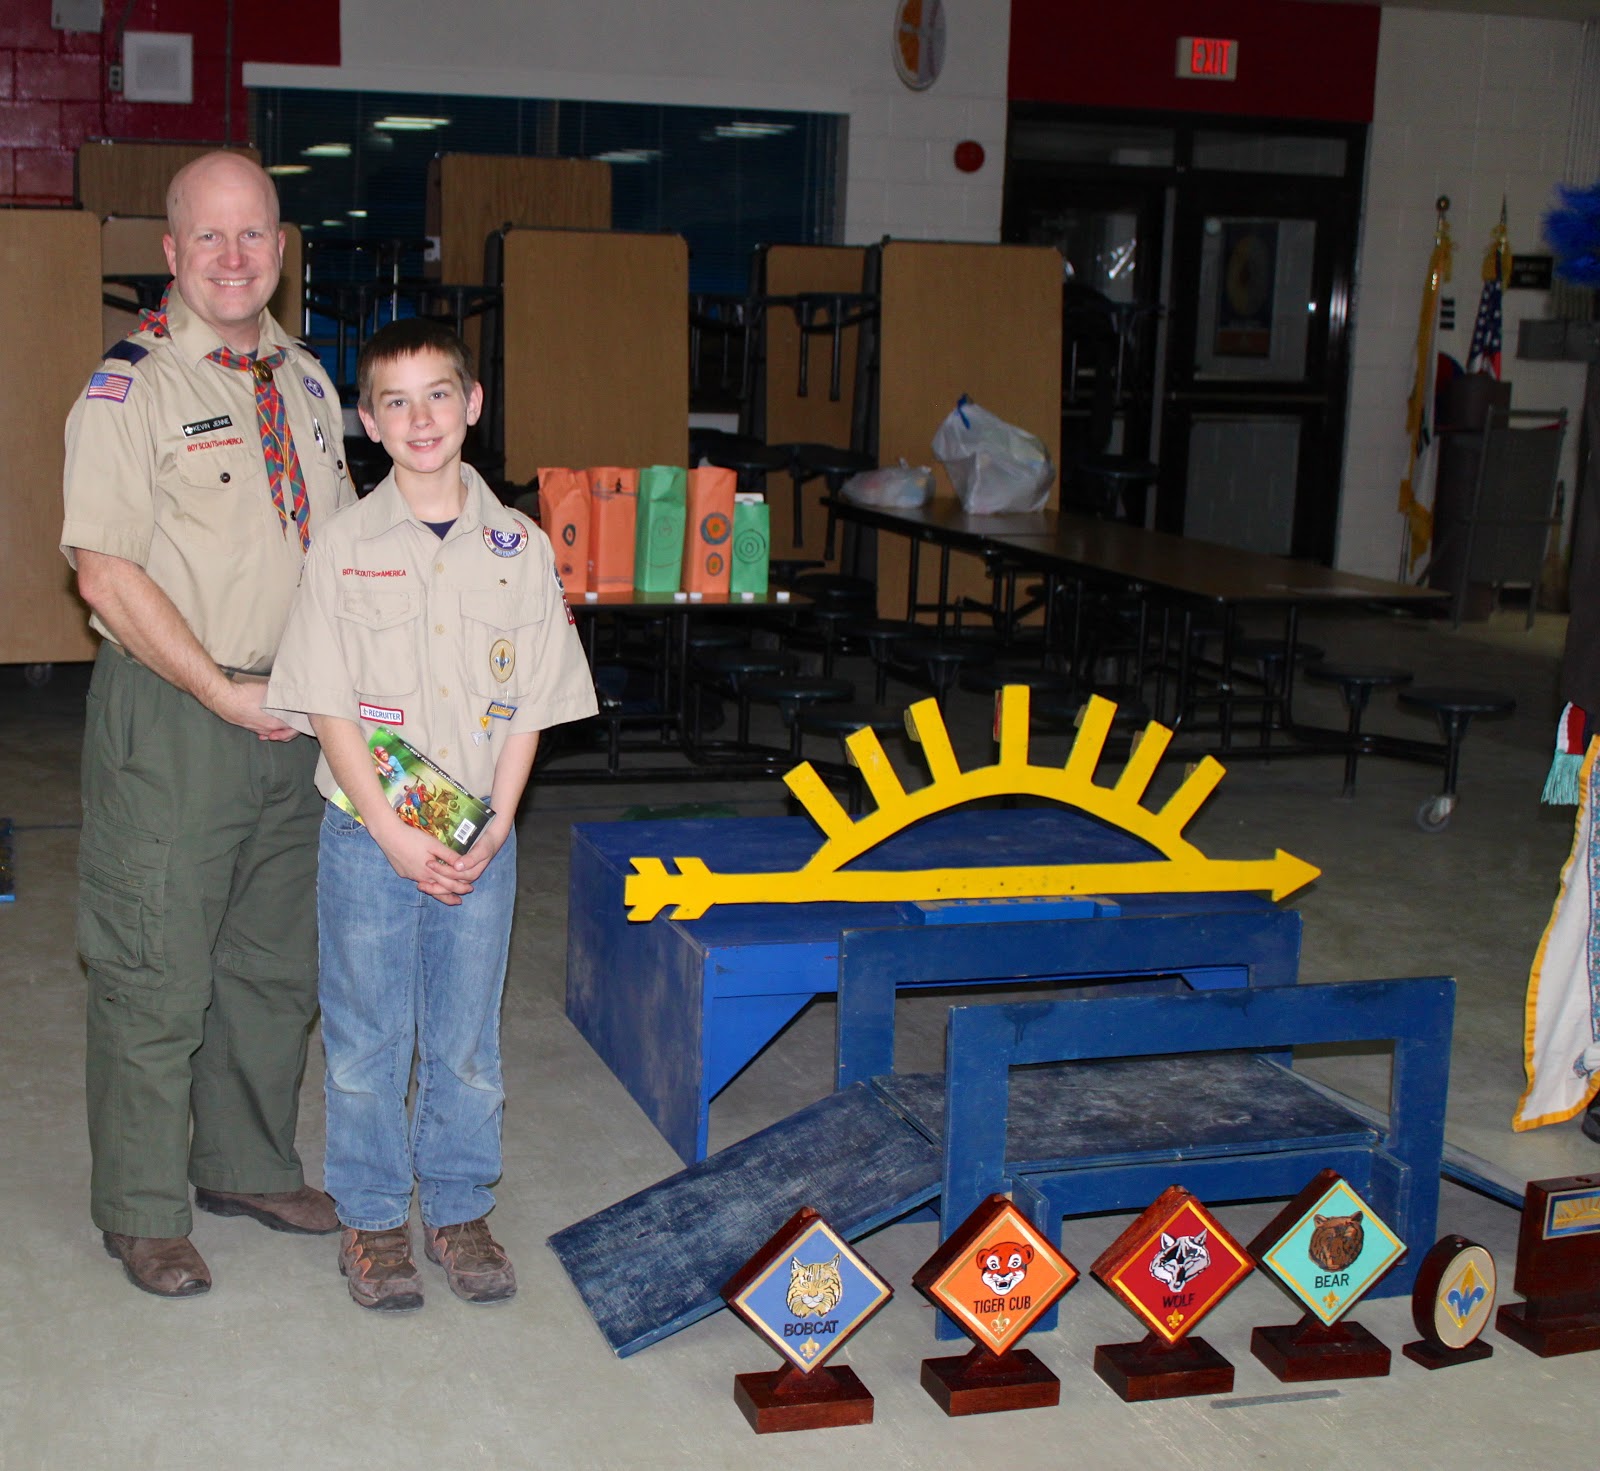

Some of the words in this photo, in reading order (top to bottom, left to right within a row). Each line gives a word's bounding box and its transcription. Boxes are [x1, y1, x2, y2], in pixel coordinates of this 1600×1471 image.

[1191, 37, 1231, 75] EXIT
[193, 422, 211, 432] KEVIN
[187, 443, 198, 452] BOY
[199, 440, 219, 450] SCOUTS
[222, 437, 244, 447] AMERICA
[342, 568, 354, 576] BOY
[354, 569, 376, 578] SCOUTS
[381, 569, 407, 577] AMERICA
[368, 708, 401, 721] RECRUITER
[420, 757, 440, 773] SCOUT
[1314, 1272, 1350, 1289] BEAR
[973, 1298, 1006, 1314] TIGER
[1009, 1295, 1031, 1311] CUB
[1162, 1292, 1197, 1309] WOLF
[784, 1319, 839, 1337] BOBCAT
